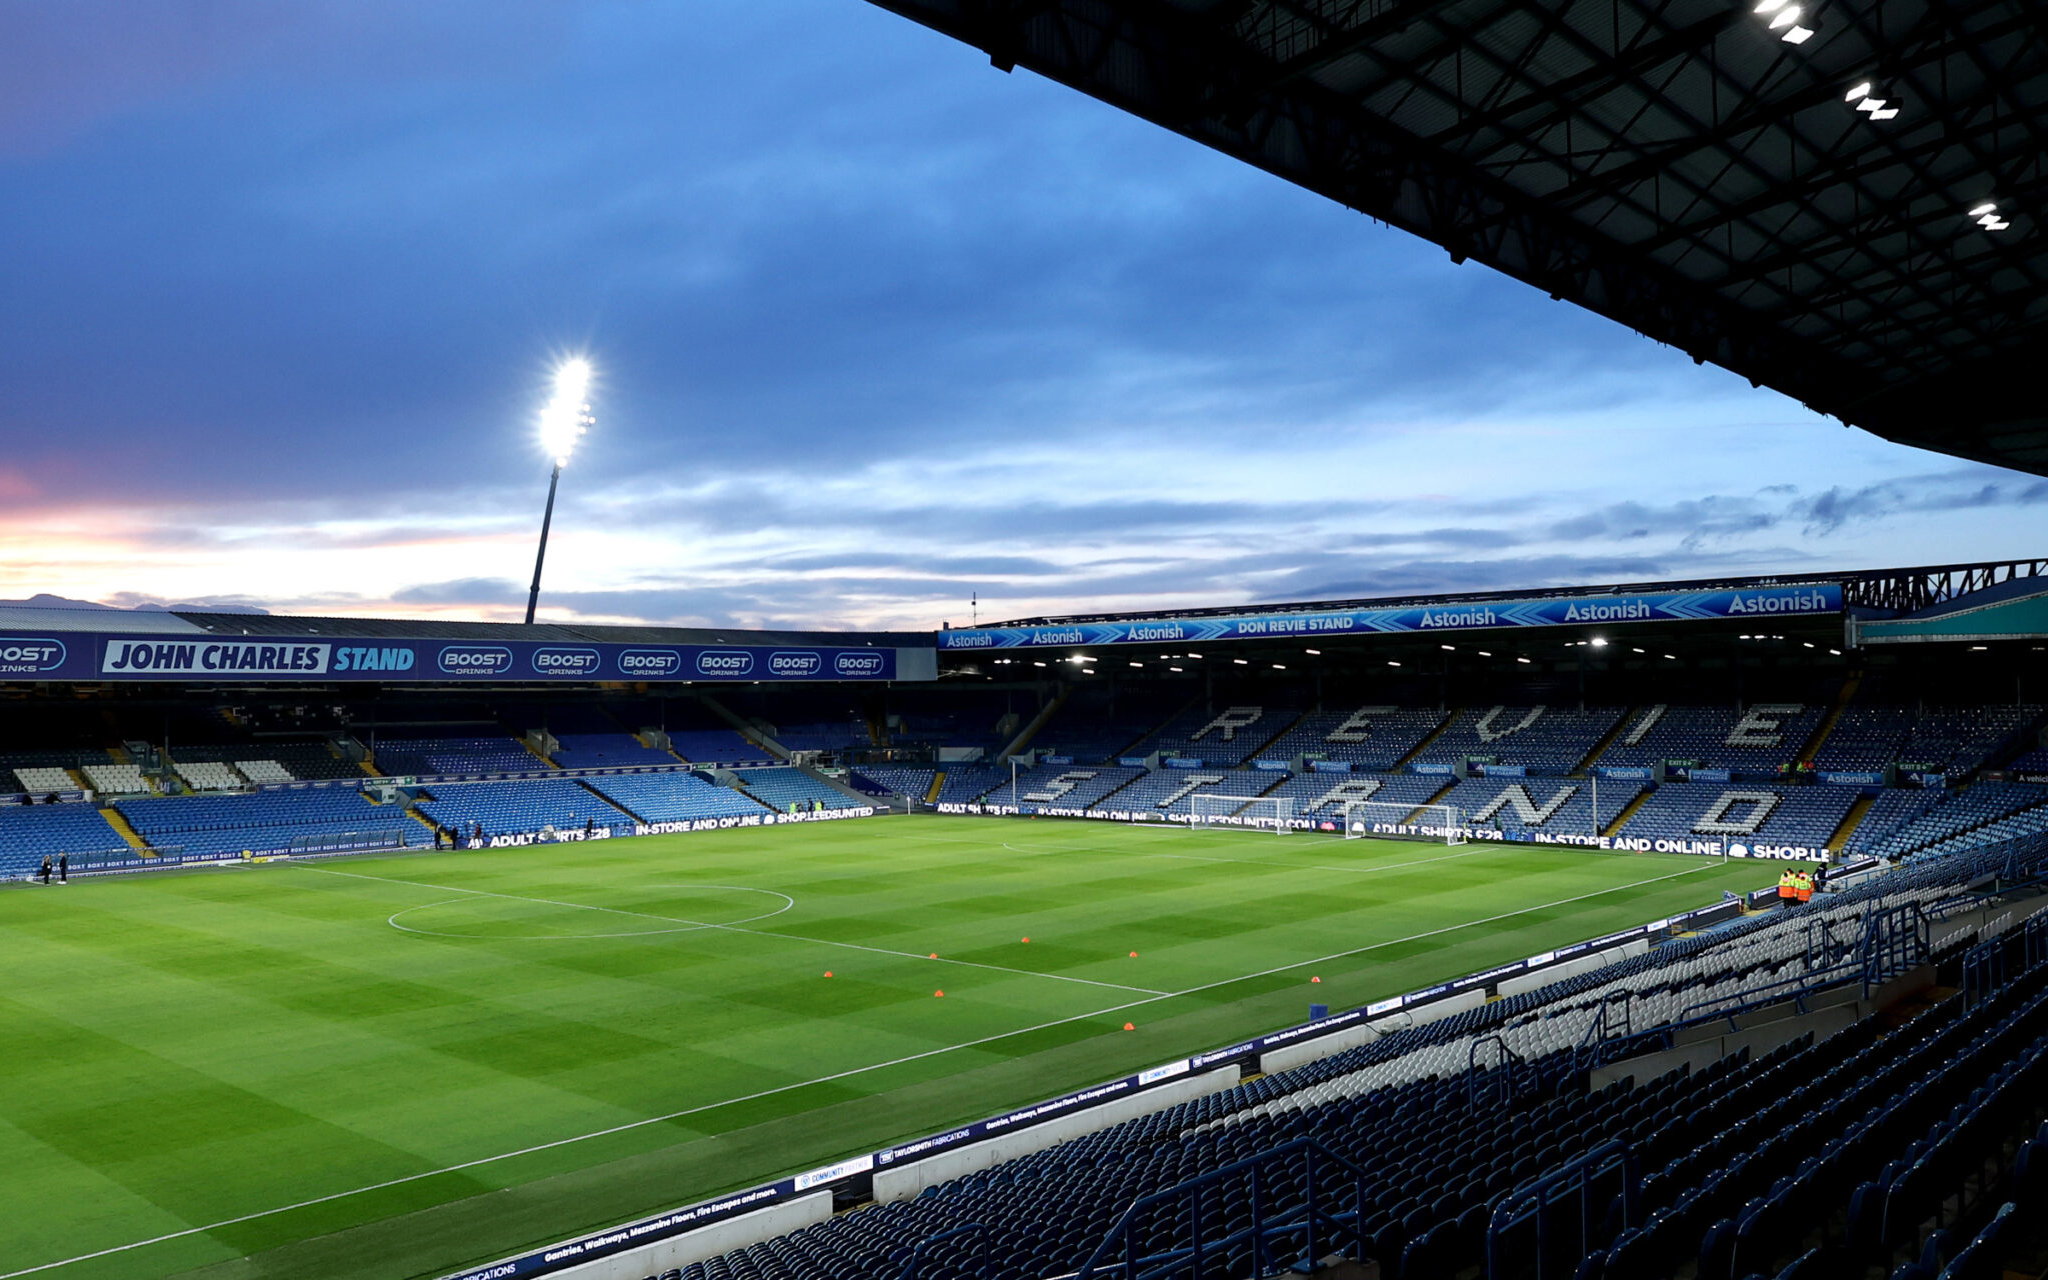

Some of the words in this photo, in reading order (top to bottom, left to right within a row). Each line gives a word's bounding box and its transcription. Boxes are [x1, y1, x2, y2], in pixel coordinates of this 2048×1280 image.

[1728, 590, 1826, 614] Astonish
[1420, 607, 1495, 627] Astonish
[1564, 599, 1650, 621] Astonish
[1127, 624, 1184, 640] Astonish
[1238, 622, 1266, 634] DON
[1269, 620, 1306, 632] REVIE
[1309, 618, 1353, 630] STAND
[946, 633, 992, 648] Astonish
[1032, 628, 1082, 644] Astonish
[0, 647, 57, 662] OST
[111, 644, 196, 670] JOHN
[202, 645, 320, 670] CHARLES
[333, 647, 414, 671] STAND
[444, 653, 506, 666] BOOST
[538, 655, 594, 666] BOOST
[624, 656, 675, 668] BOOST
[702, 657, 748, 668] BOOST
[772, 658, 816, 668] BOOST
[839, 658, 879, 668] BOOST
[1258, 762, 1286, 770] Astonish
[1416, 766, 1450, 774] Astonish
[1606, 769, 1644, 778] Astonish
[1827, 774, 1874, 784] Astonish
[2019, 774, 2025, 782] A
[938, 802, 966, 812] ADULT
[777, 806, 874, 824] SHOP.LEEDSUNITED
[636, 820, 692, 836] IN-STORE
[692, 819, 718, 830] AND
[490, 834, 535, 848] ADULT
[1535, 833, 1610, 849] IN-STORE
[1614, 837, 1650, 851] AND
[1655, 839, 1720, 856] ONLINE
[1754, 844, 1830, 862] SHOP.LE
[894, 1140, 932, 1158] TAYLORSMITH
[932, 1129, 970, 1146] FABRICATIONS
[812, 1167, 844, 1182] COMMUNITY
[544, 1245, 584, 1262] Gantries,
[584, 1232, 629, 1250] Walkways,
[630, 1218, 671, 1236] Mezzanine
[672, 1212, 696, 1224] Floors,
[697, 1206, 711, 1218] Fire
[712, 1199, 740, 1212] Escapes
[742, 1192, 756, 1203] and
[756, 1188, 777, 1199] more.
